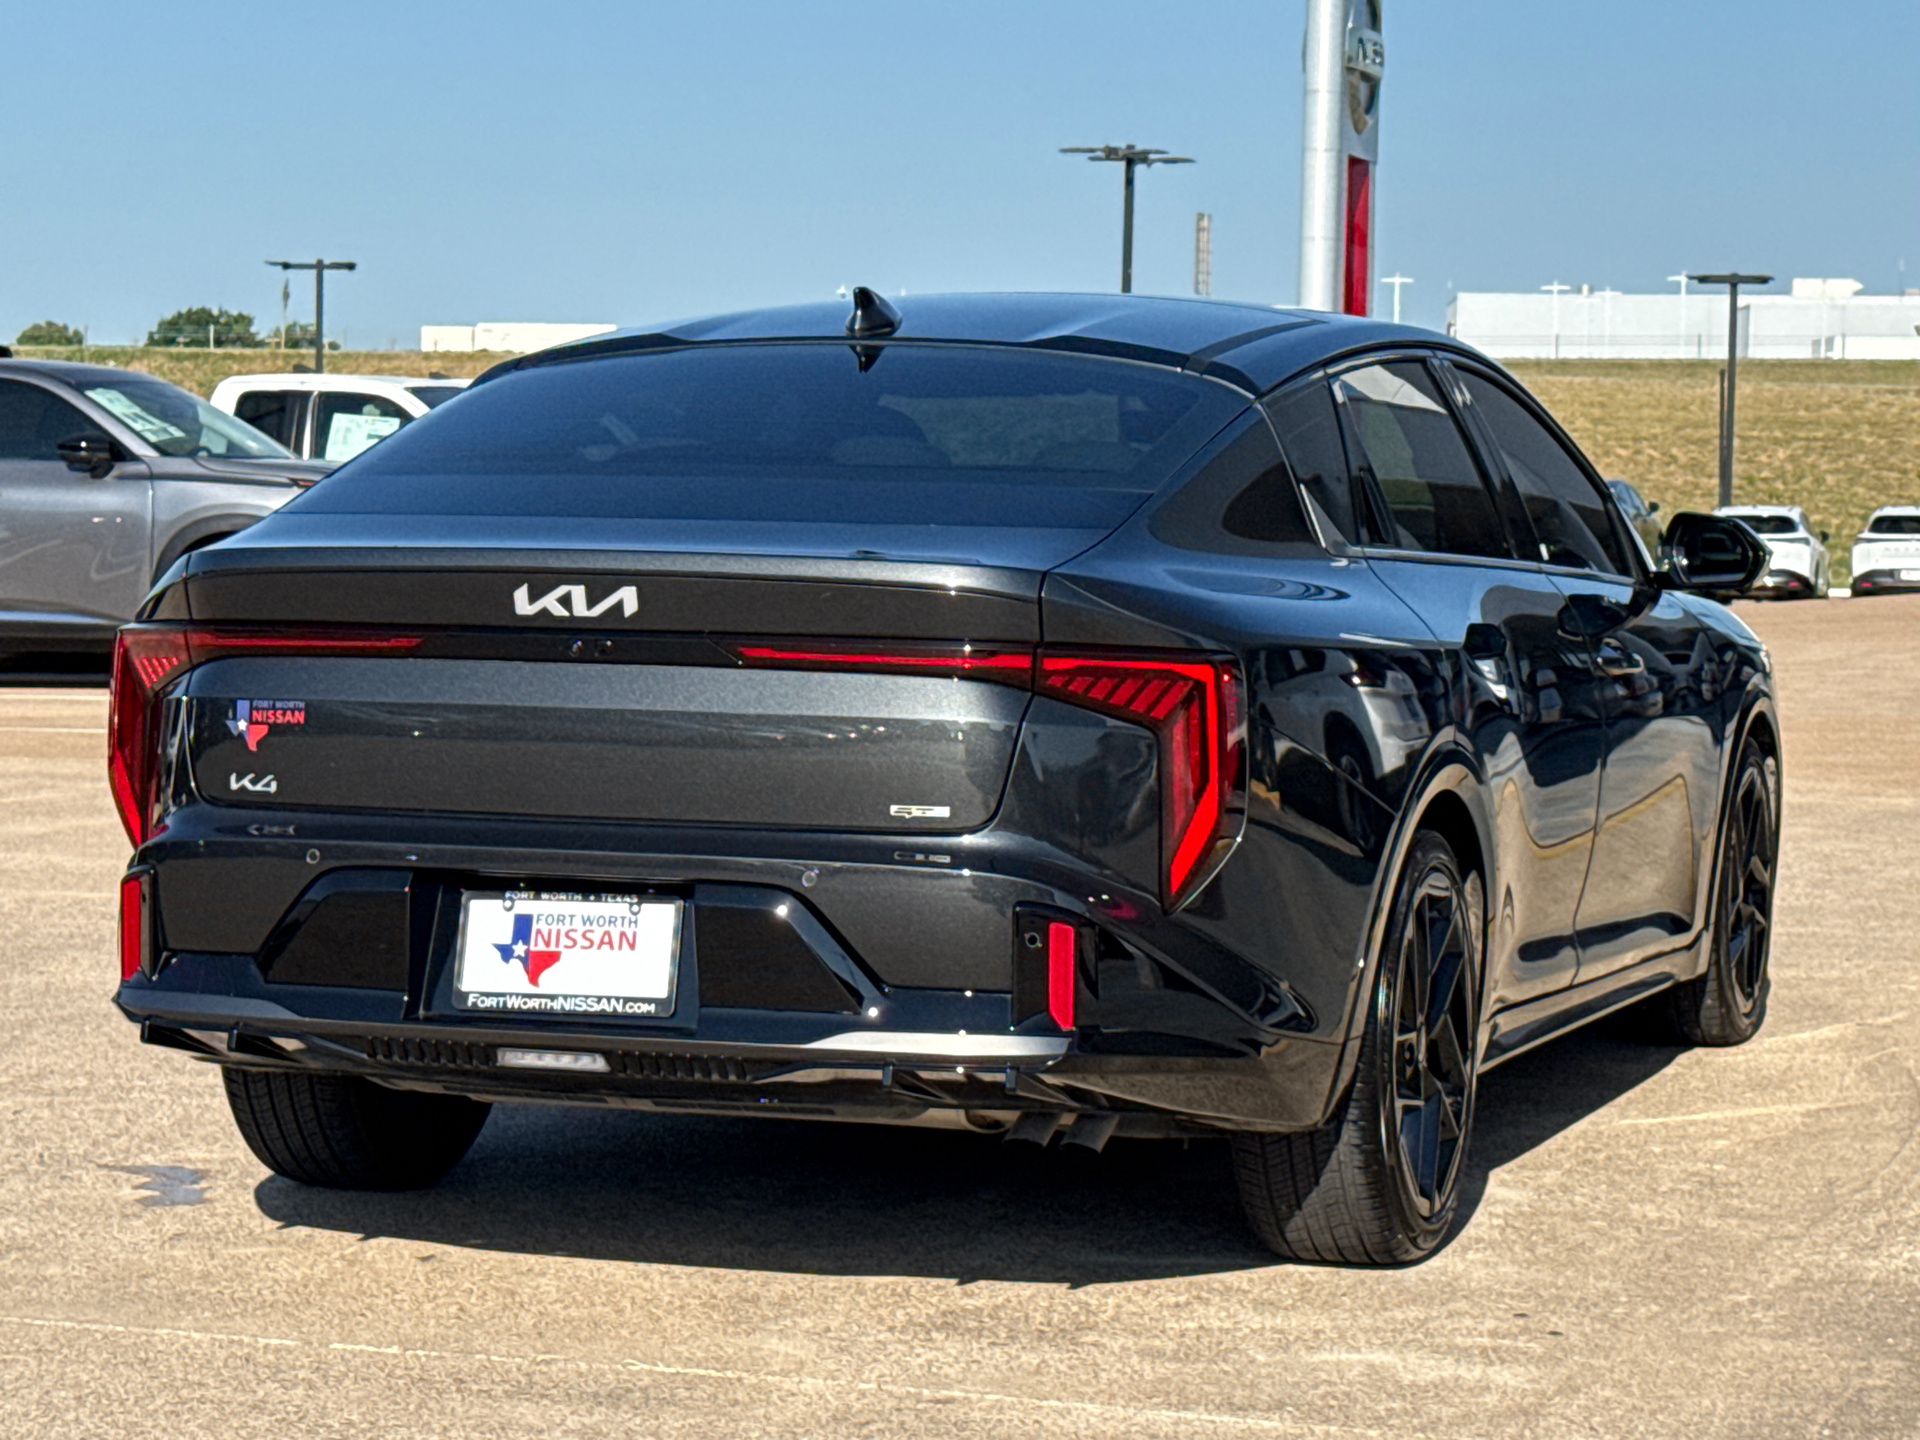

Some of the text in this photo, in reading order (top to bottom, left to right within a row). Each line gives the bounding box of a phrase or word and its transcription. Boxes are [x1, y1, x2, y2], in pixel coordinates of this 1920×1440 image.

[513, 582, 639, 618] KIA
[252, 700, 305, 709] FORT WORTH
[252, 710, 305, 725] NISSAN
[504, 890, 639, 903] FORT WORTH TEXAS
[535, 913, 639, 929] FORT WORTH
[534, 928, 638, 952] NISSAN
